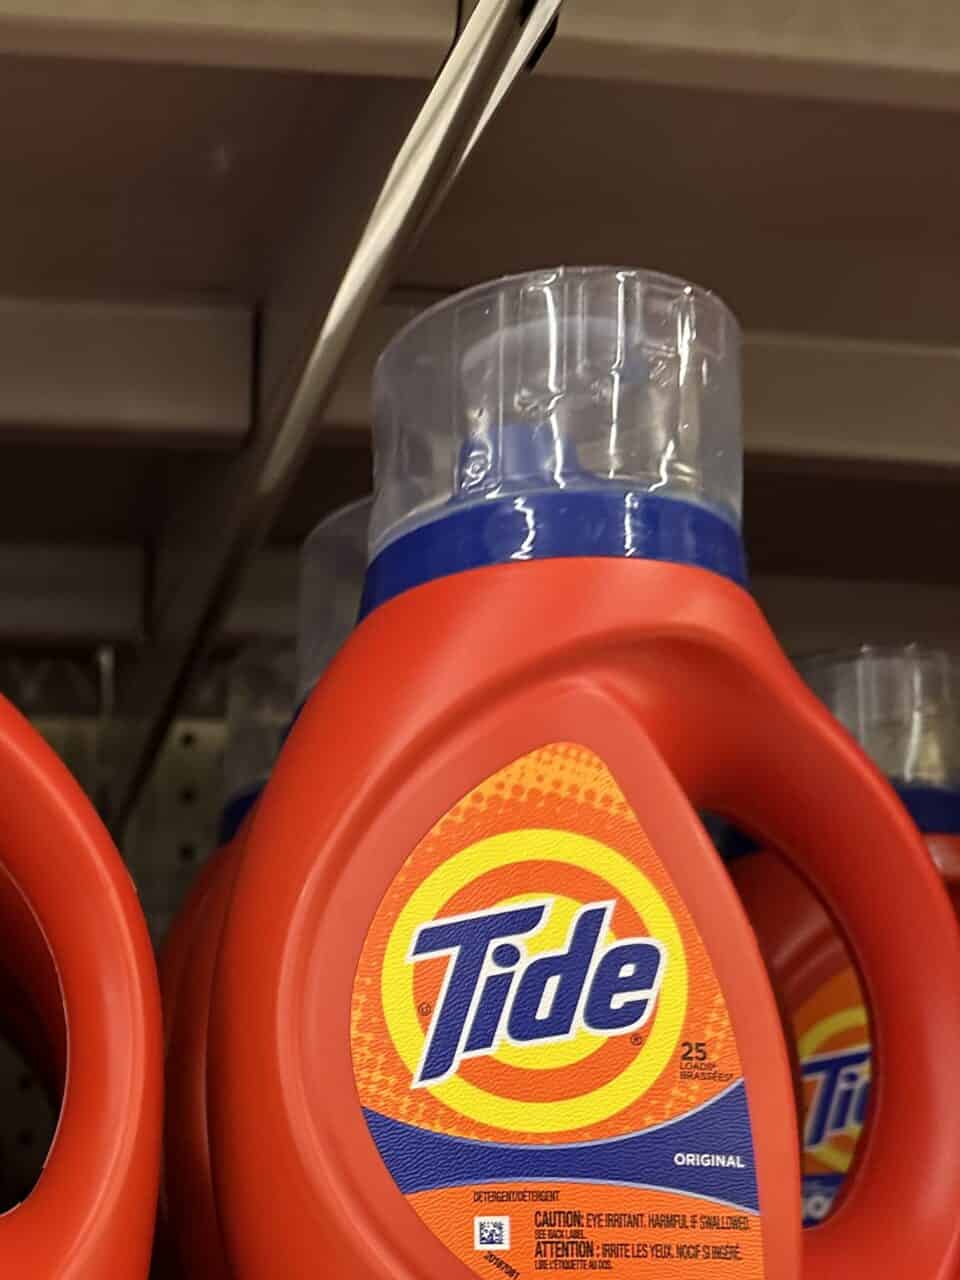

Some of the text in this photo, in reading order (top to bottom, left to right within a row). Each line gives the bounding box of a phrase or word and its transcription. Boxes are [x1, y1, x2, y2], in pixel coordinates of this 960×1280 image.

[405, 897, 666, 1090] Tide
[681, 1042, 707, 1061] 25
[674, 1153, 745, 1168] ORIGINAL
[534, 1211, 584, 1228] CAUTION:
[586, 1213, 603, 1228] EYE
